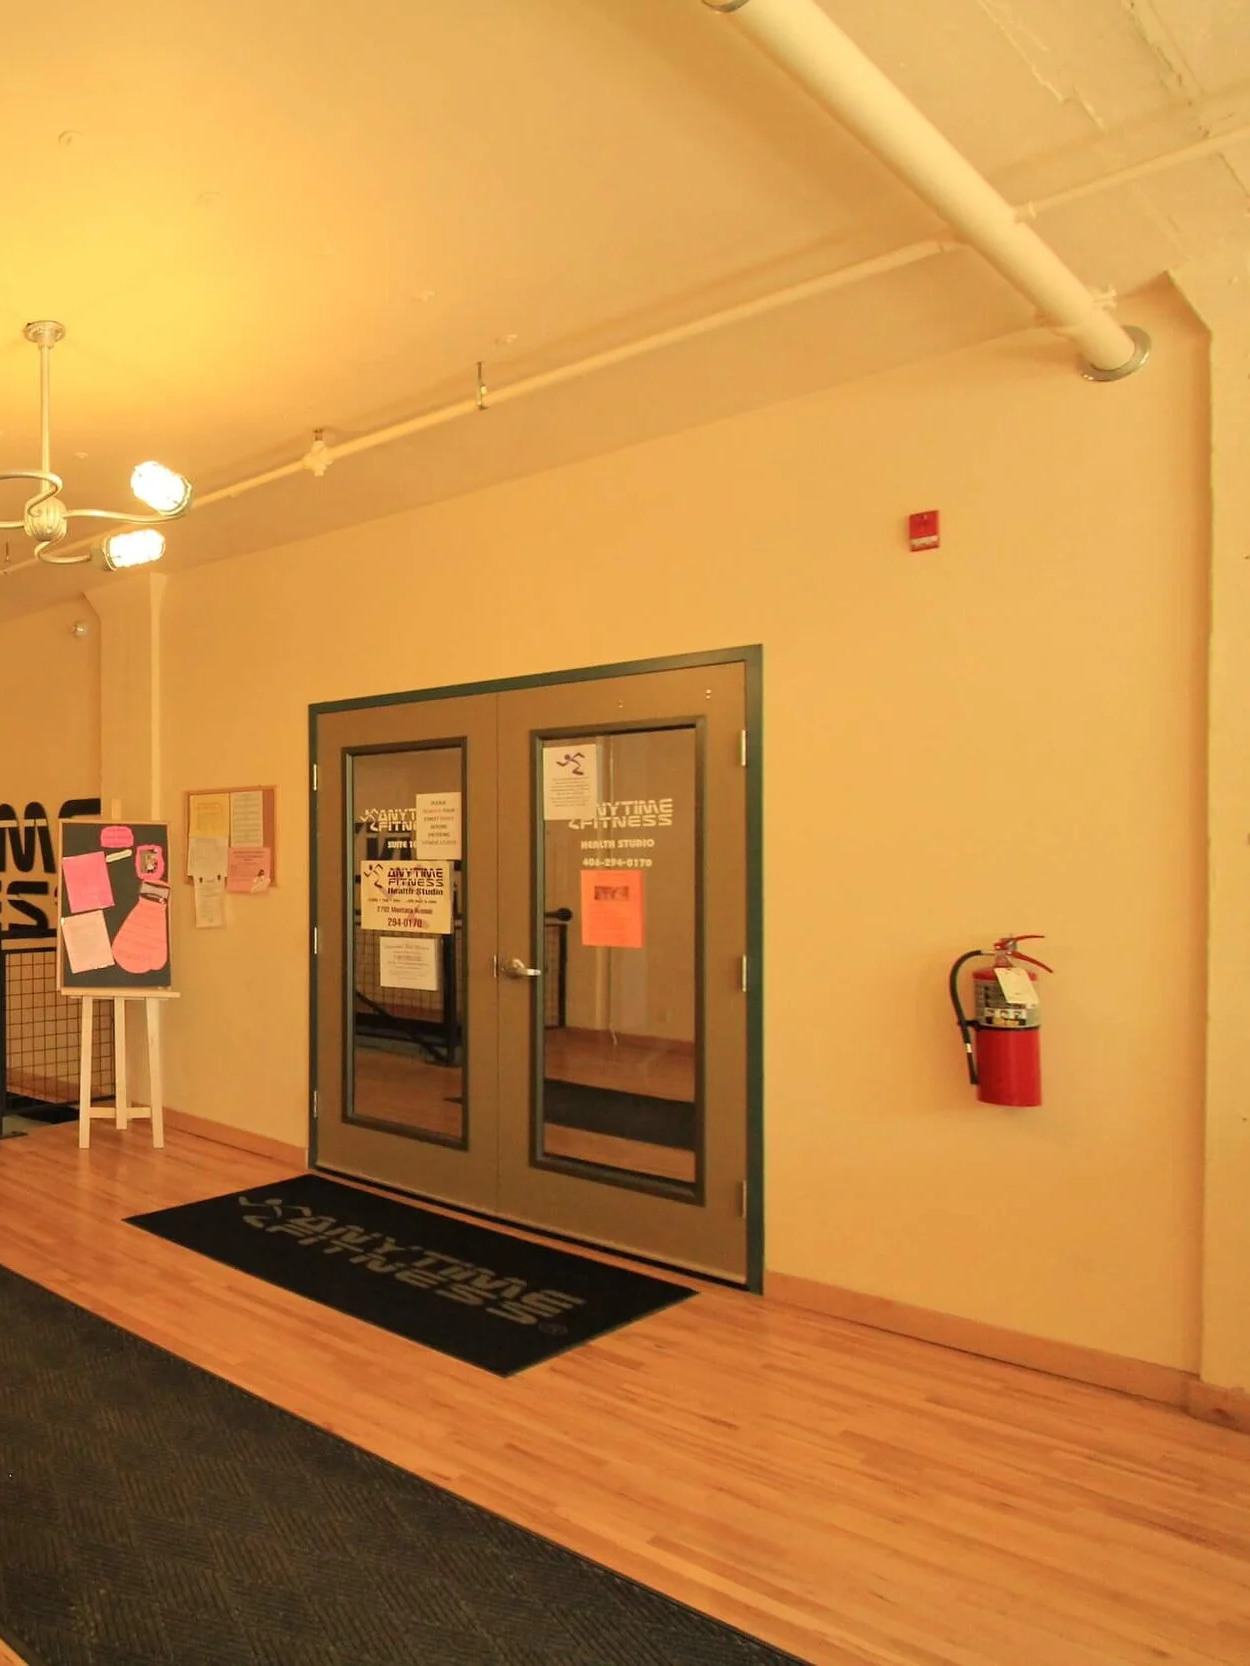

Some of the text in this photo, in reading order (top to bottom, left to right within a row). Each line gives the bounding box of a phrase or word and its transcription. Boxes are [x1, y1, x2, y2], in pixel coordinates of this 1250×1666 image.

[597, 798, 673, 816] NYTIME
[378, 808, 417, 821] ANYT
[378, 821, 417, 832] FITN
[580, 814, 672, 829] FITNESS
[580, 838, 655, 849] HEALTH STUDIO
[387, 867, 443, 878] ANYTIME
[388, 878, 444, 887] FITNESS
[416, 887, 444, 896] Studio
[286, 1214, 587, 1319] ANYTIME
[266, 1222, 539, 1326] FITNESS
